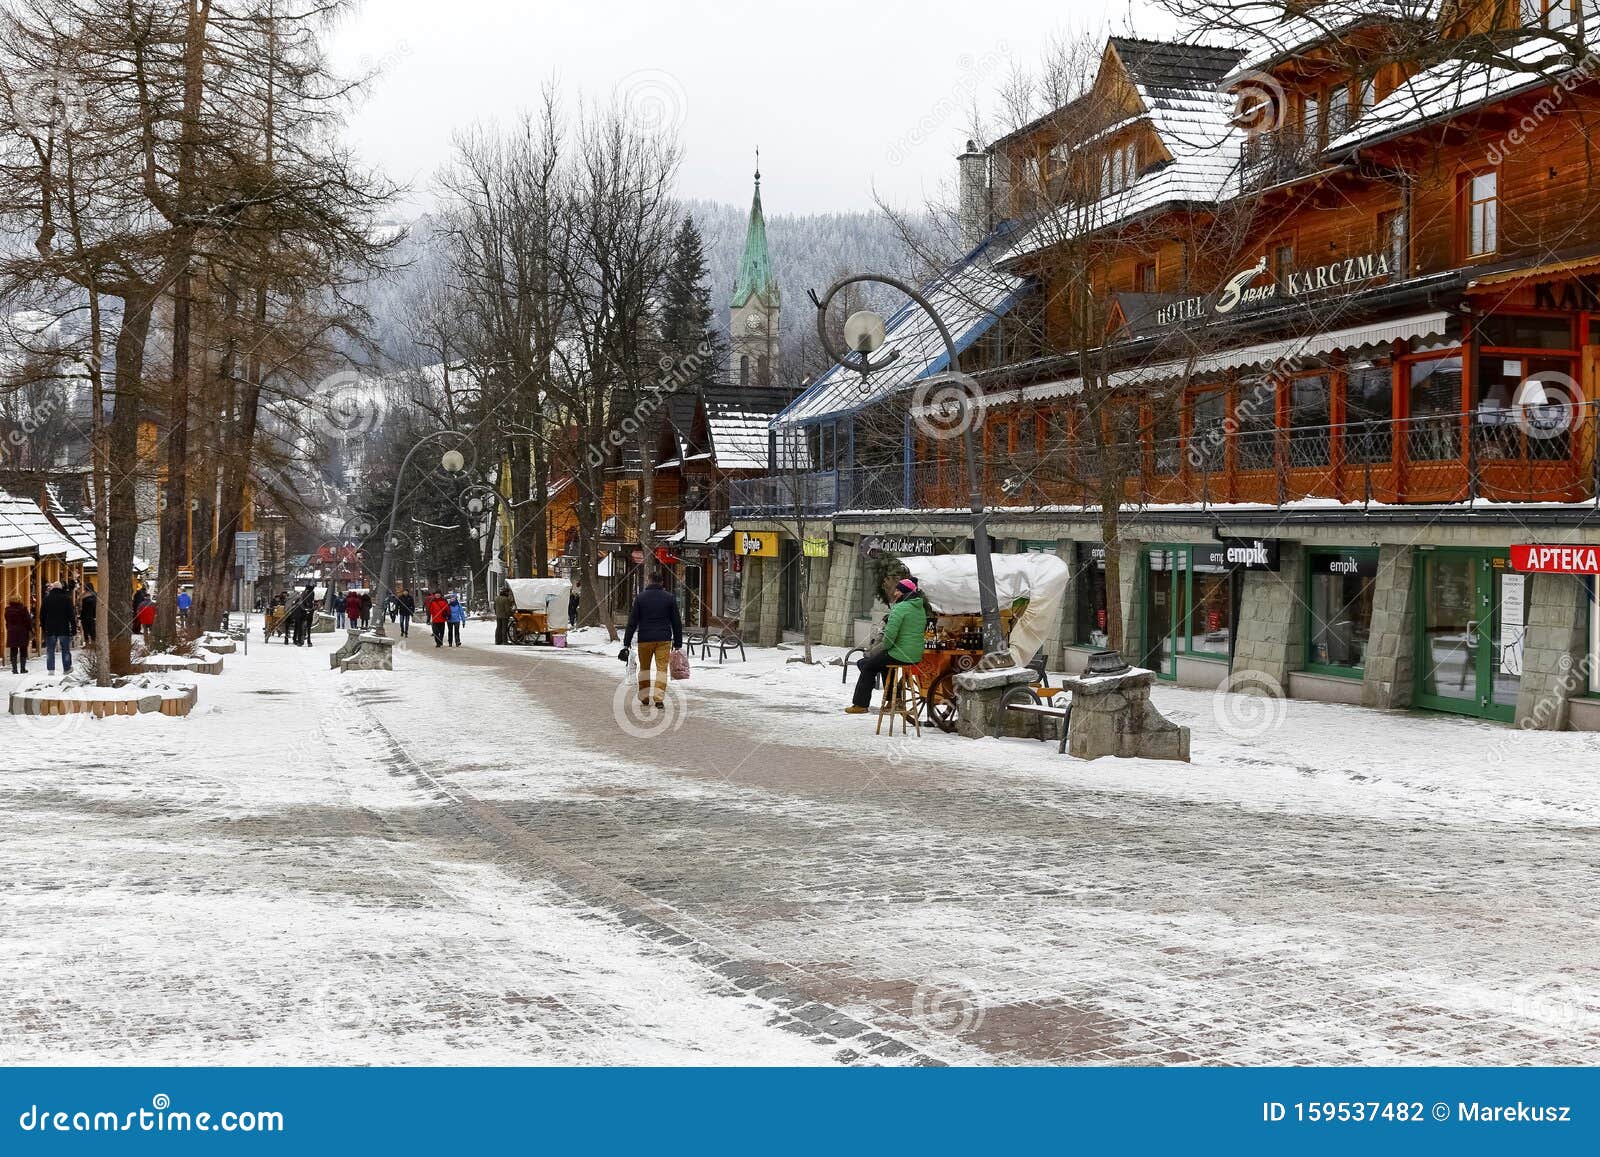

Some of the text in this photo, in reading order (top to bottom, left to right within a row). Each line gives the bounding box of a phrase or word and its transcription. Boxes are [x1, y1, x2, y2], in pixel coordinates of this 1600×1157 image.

[1157, 296, 1206, 326] HOTEL
[1287, 254, 1391, 297] KARCZMA
[1535, 280, 1600, 311] KA
[1227, 541, 1269, 568] empik
[1330, 556, 1358, 575] empik
[1526, 548, 1599, 571] APTEKA
